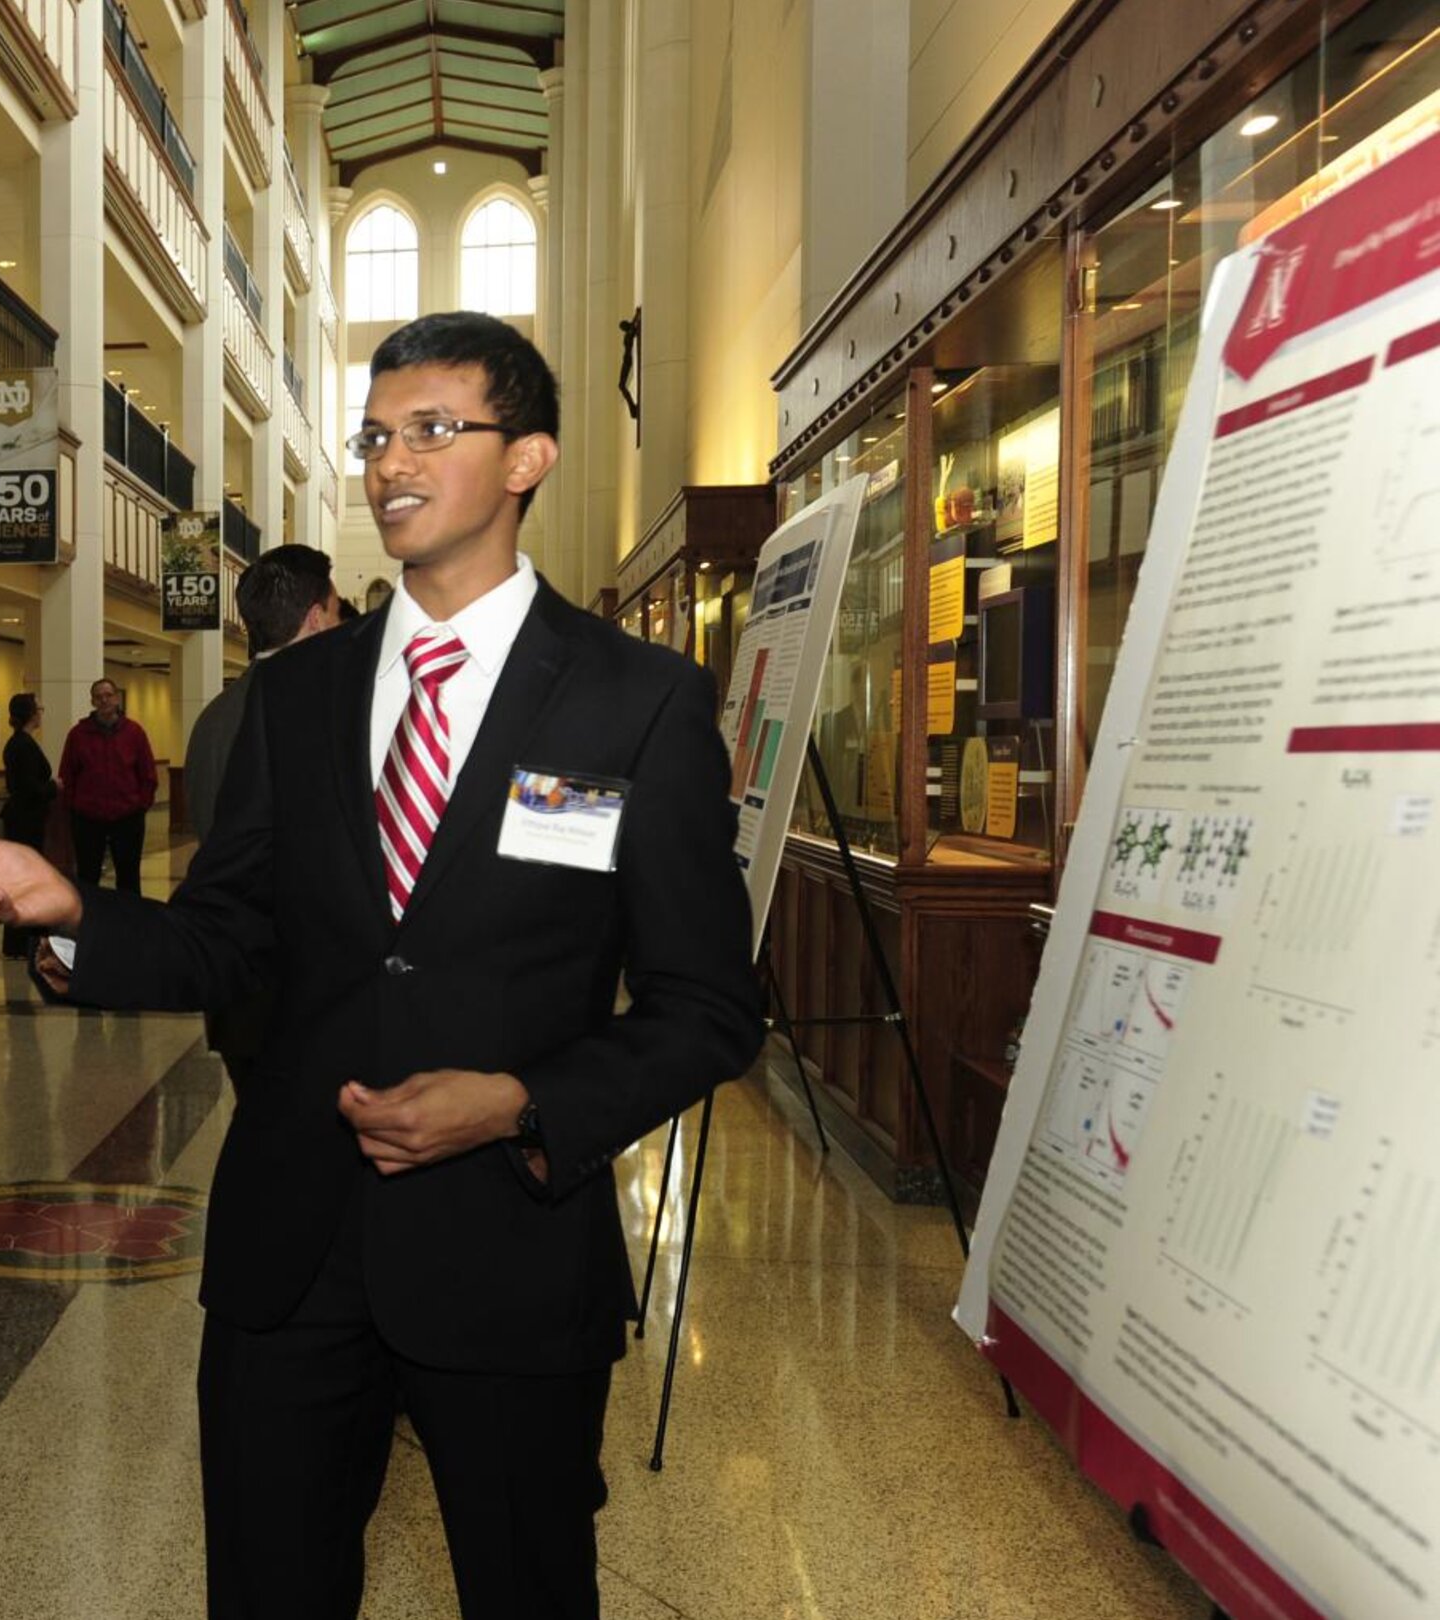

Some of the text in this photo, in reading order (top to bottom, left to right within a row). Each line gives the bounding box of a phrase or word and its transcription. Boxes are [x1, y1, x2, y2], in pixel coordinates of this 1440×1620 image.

[38, 510, 49, 523] of
[166, 575, 216, 597] 150
[167, 596, 208, 607] YEARS
